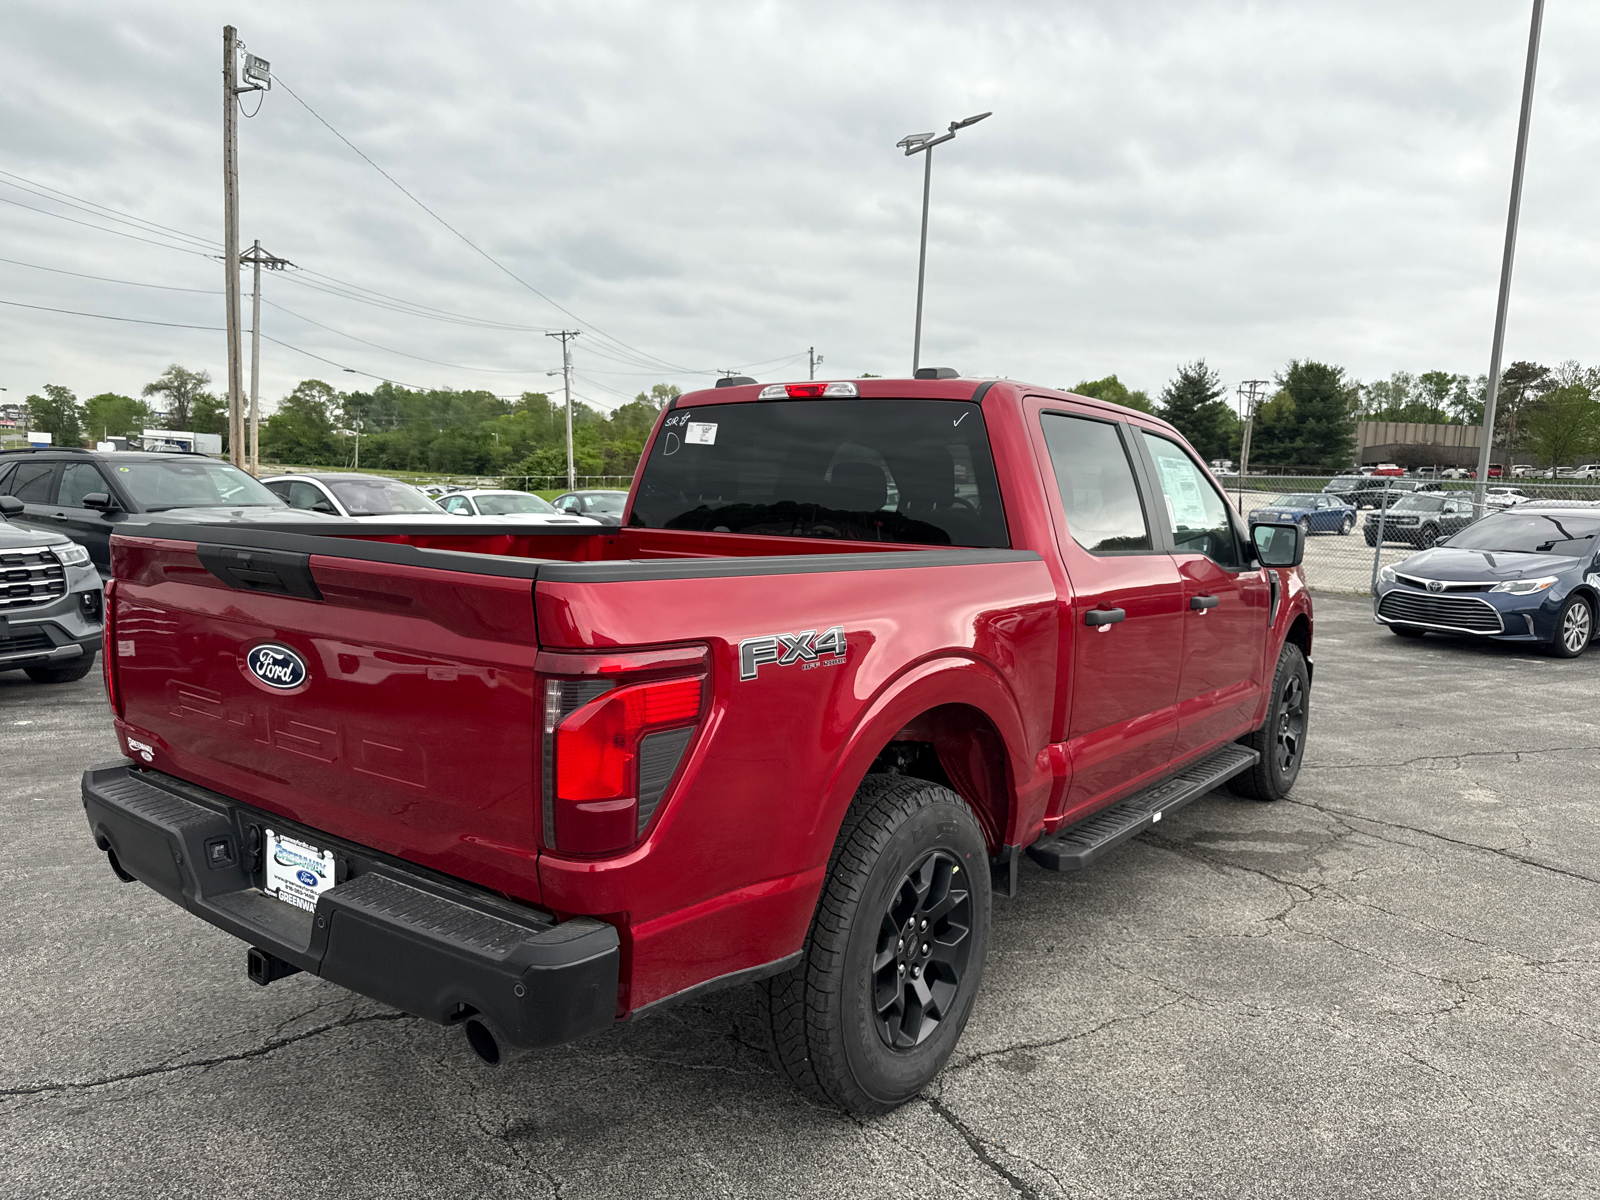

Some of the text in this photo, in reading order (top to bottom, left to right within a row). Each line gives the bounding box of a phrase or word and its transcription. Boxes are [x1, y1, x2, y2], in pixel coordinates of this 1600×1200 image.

[254, 648, 295, 684] Ford
[738, 625, 847, 682] FX4
[801, 657, 847, 671] OFF ROAD
[274, 843, 327, 878] GREENWAY
[278, 890, 317, 914] GREENWA
